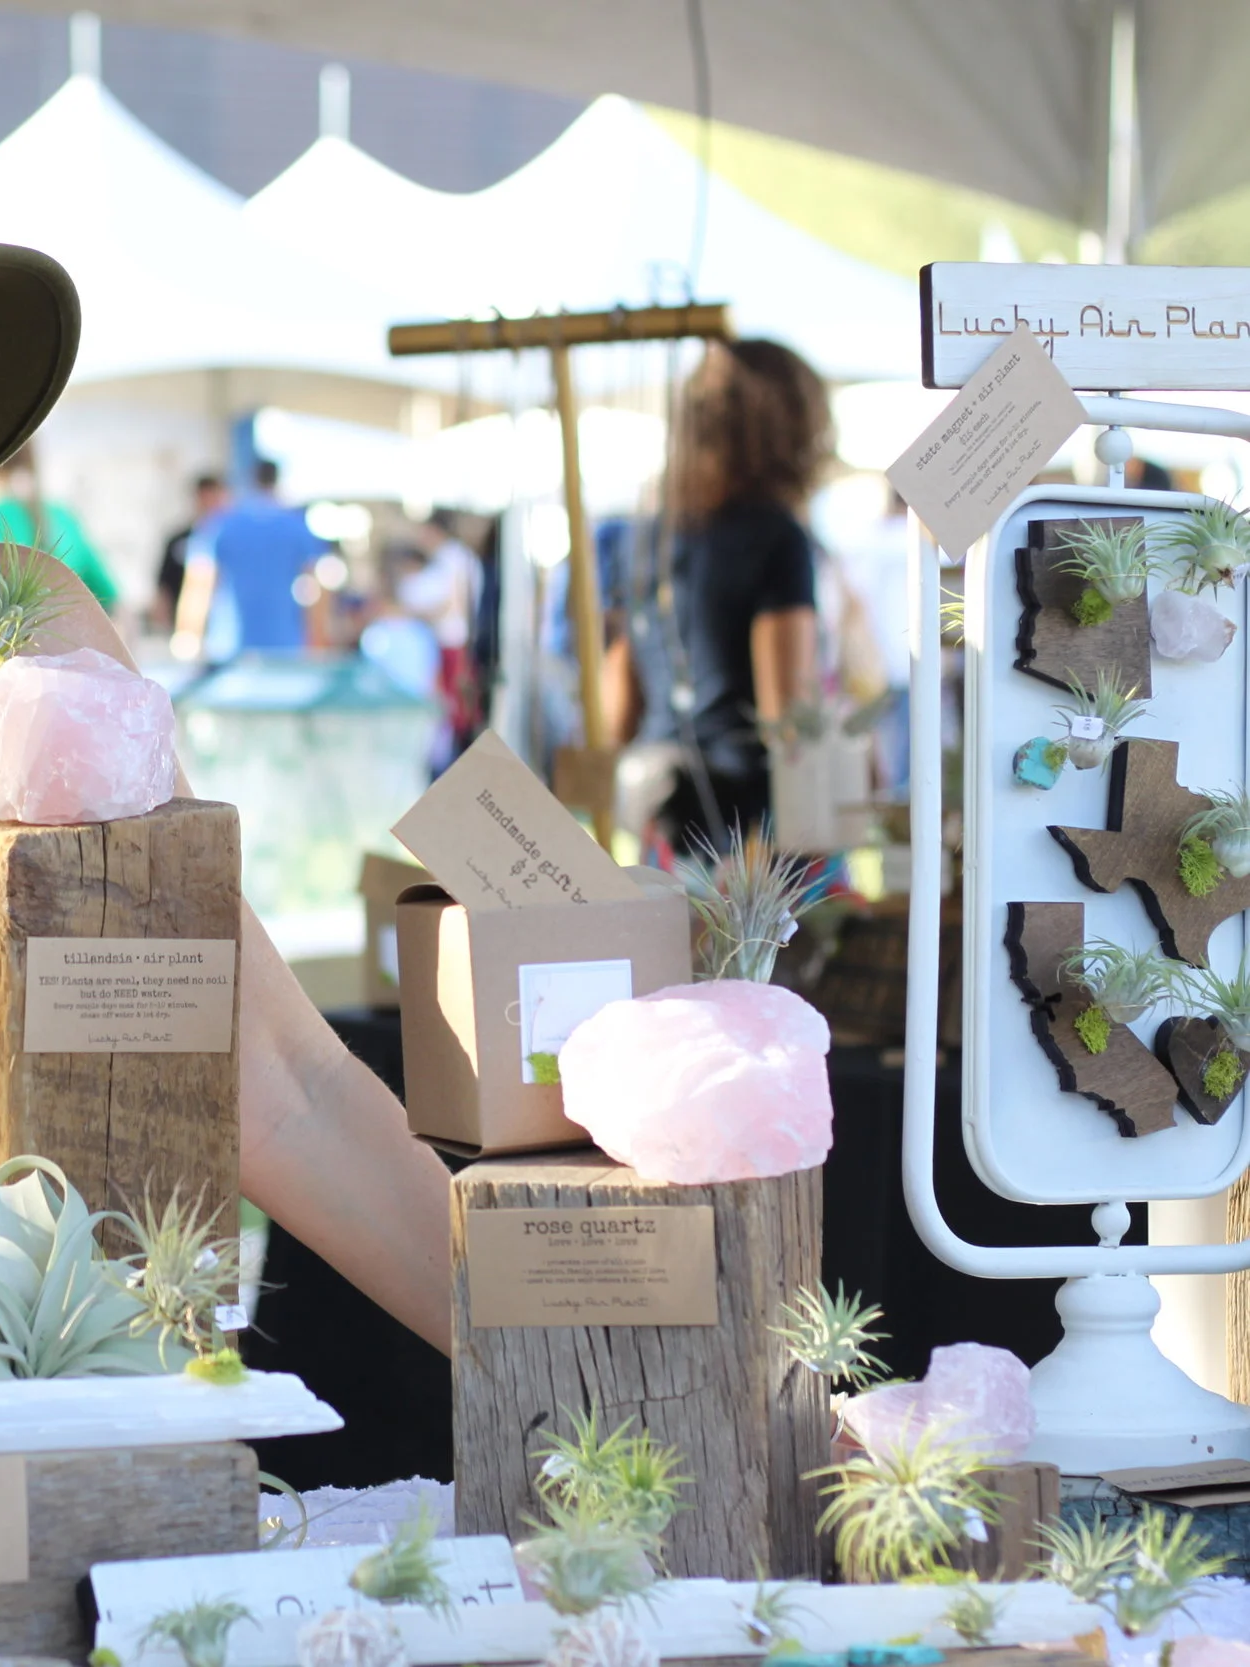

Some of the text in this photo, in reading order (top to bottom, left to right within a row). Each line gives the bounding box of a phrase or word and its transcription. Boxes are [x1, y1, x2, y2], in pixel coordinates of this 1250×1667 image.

[938, 301, 1069, 359] Lucky
[1080, 305, 1156, 338] Air
[914, 440, 942, 470] state
[938, 406, 974, 443] magnet
[976, 382, 995, 401] air
[992, 352, 1023, 385] plant
[971, 412, 989, 431] each
[1019, 439, 1043, 464] Plant
[476, 789, 543, 860] Handmade
[537, 860, 572, 892] gift
[64, 952, 203, 966] tillandsia air plant
[62, 977, 93, 986] Plants
[115, 977, 139, 986] real,
[143, 977, 163, 987] they
[167, 977, 189, 985] need
[207, 976, 227, 985] soil
[81, 989, 172, 998] but do NEED water.
[143, 1033, 172, 1043] Plant
[524, 1217, 656, 1238] rose quartz
